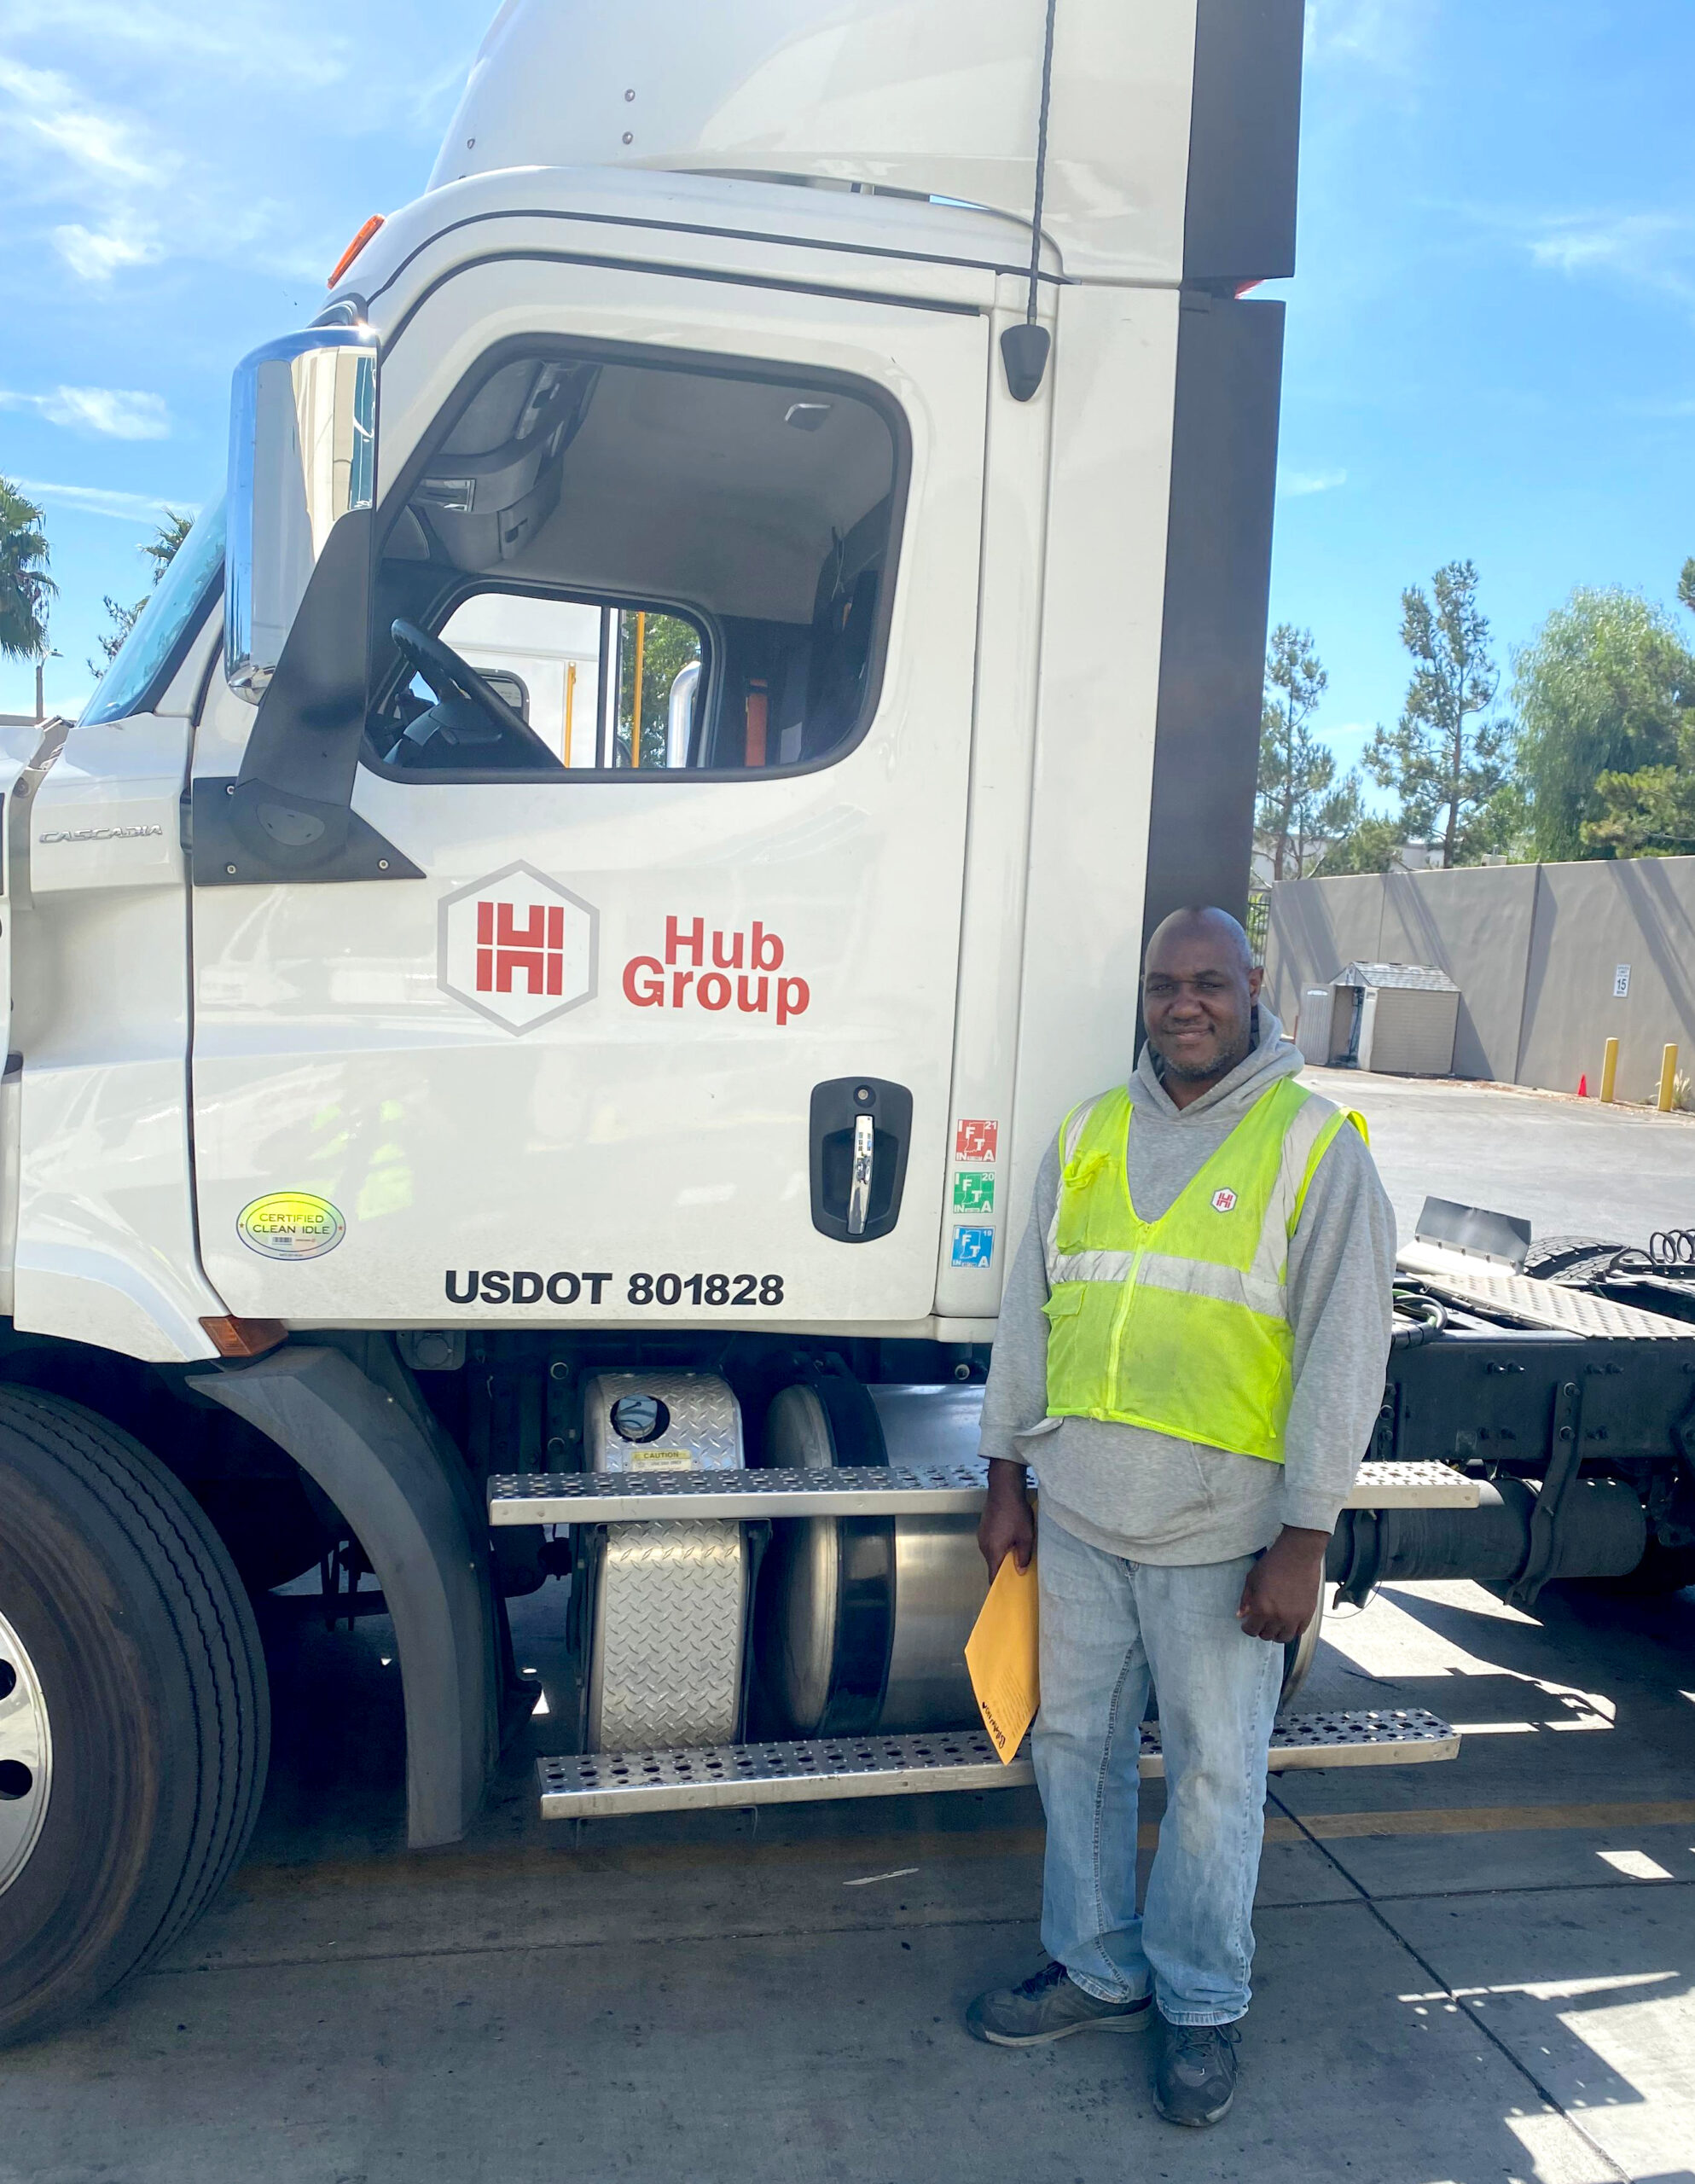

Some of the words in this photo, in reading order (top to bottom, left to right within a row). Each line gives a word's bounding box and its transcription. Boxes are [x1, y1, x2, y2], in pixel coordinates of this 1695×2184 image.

[39, 824, 163, 844] CASCADIA
[665, 915, 784, 971] Hub
[1617, 979, 1627, 990] 15
[622, 956, 810, 1025] Group
[984, 1121, 997, 1130] 21
[982, 1173, 995, 1182] 20
[259, 1213, 324, 1223] CERTIFIED
[253, 1224, 296, 1234] CLEAN
[302, 1226, 331, 1234] IDLE
[444, 1270, 613, 1304] USDOT
[627, 1273, 785, 1306] 801828
